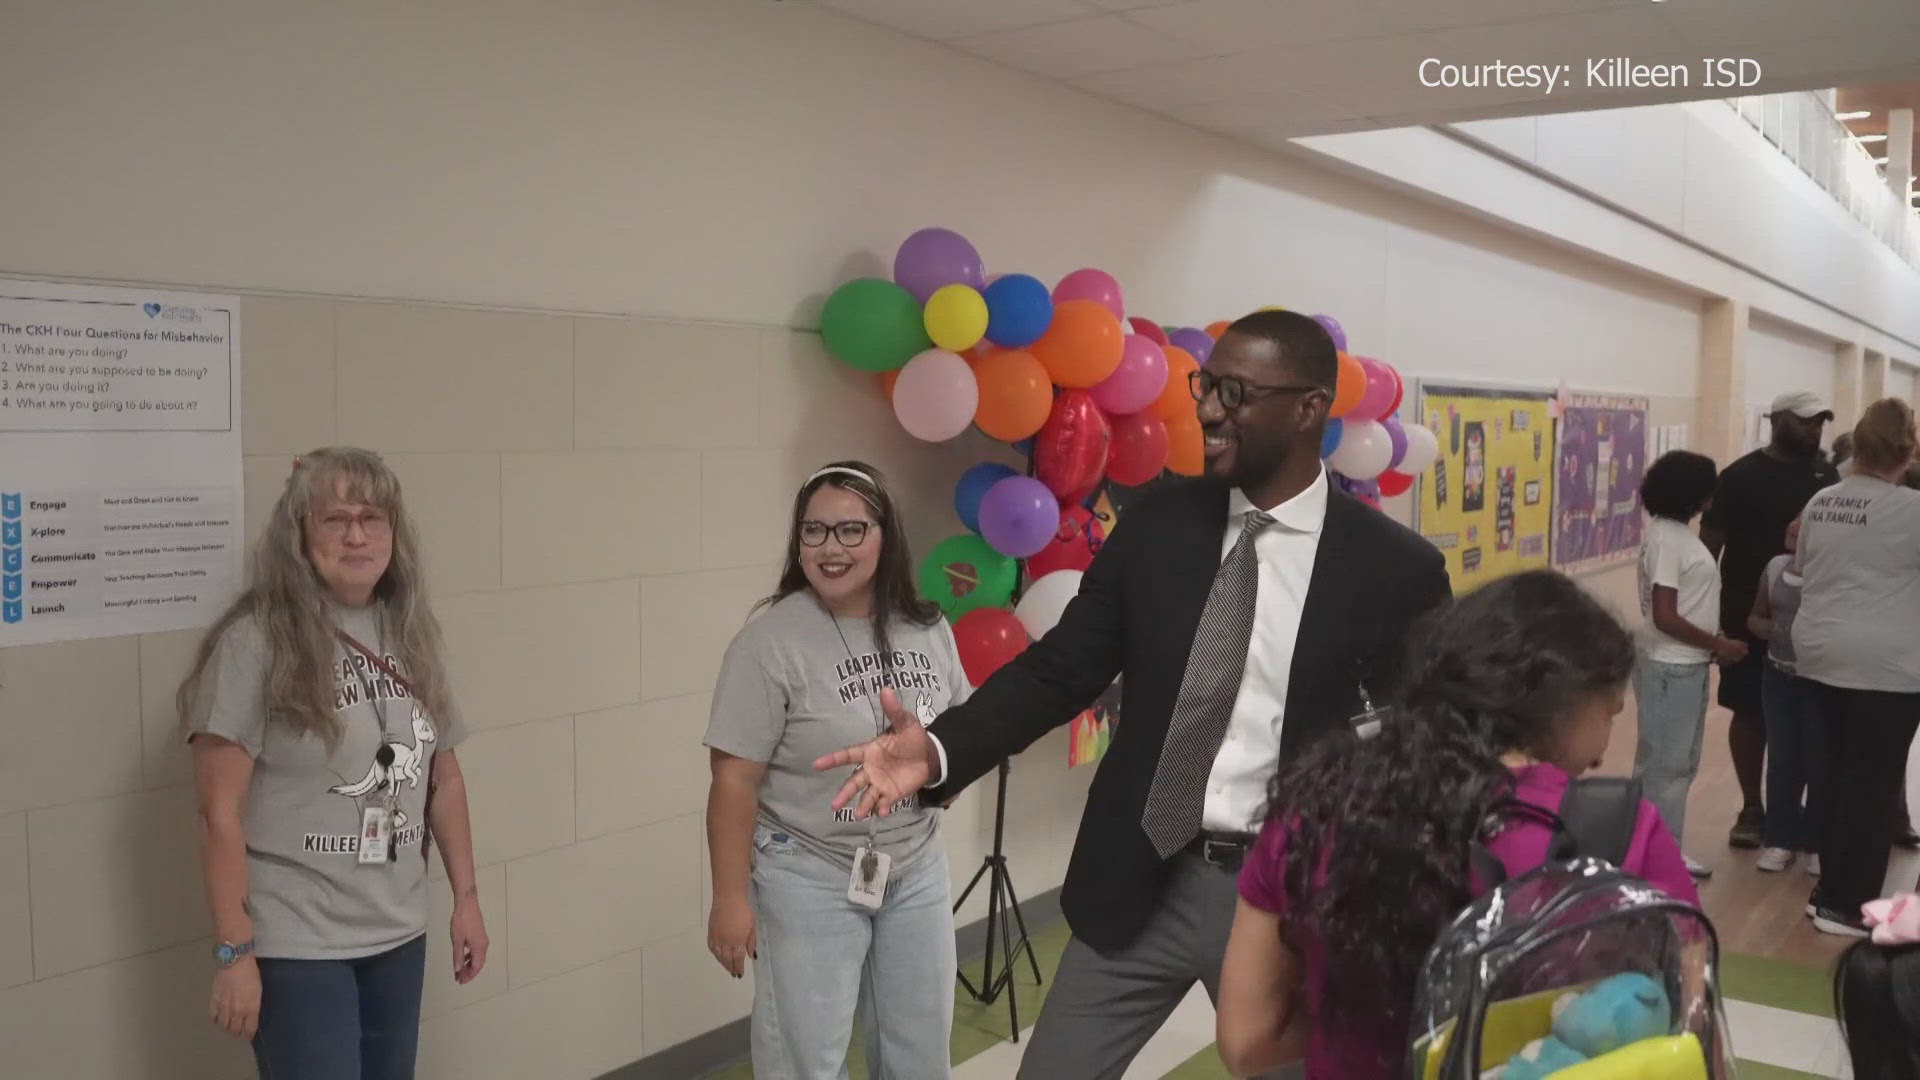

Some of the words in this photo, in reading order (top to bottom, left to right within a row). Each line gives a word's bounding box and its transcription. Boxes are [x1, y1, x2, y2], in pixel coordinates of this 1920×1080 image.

[0, 323, 22, 335] The
[26, 325, 53, 336] CKH
[86, 328, 141, 341] Questions
[144, 329, 158, 340] for
[161, 331, 224, 344] Misbehavior
[15, 343, 44, 355] What
[48, 346, 66, 356] are
[69, 347, 89, 358] you
[92, 347, 128, 360] doing?
[16, 362, 45, 373] What
[48, 364, 65, 374] are
[69, 366, 89, 376] you
[92, 366, 143, 378] supposed
[146, 368, 156, 377] to
[158, 367, 172, 377] be
[174, 367, 208, 380] doing?
[16, 380, 36, 391] Are
[39, 382, 59, 393] you
[62, 381, 94, 394] doing
[97, 382, 110, 392] it?
[16, 397, 46, 409] What
[49, 399, 66, 409] are
[70, 401, 89, 412] you
[92, 401, 123, 412] going
[125, 401, 136, 410] to
[139, 400, 152, 410] do
[155, 401, 184, 411] about
[186, 401, 198, 411] it?
[30, 501, 67, 512] Engage
[1834, 497, 1871, 509] FAMILY
[1826, 512, 1868, 526] FAMILIA
[31, 527, 66, 538] X-plore
[31, 552, 96, 563] Communicate
[31, 579, 77, 590] Empower
[31, 603, 65, 615] Launch
[907, 651, 932, 670] TO
[870, 671, 941, 693] HEIGHTS
[303, 834, 361, 853] KILLEE
